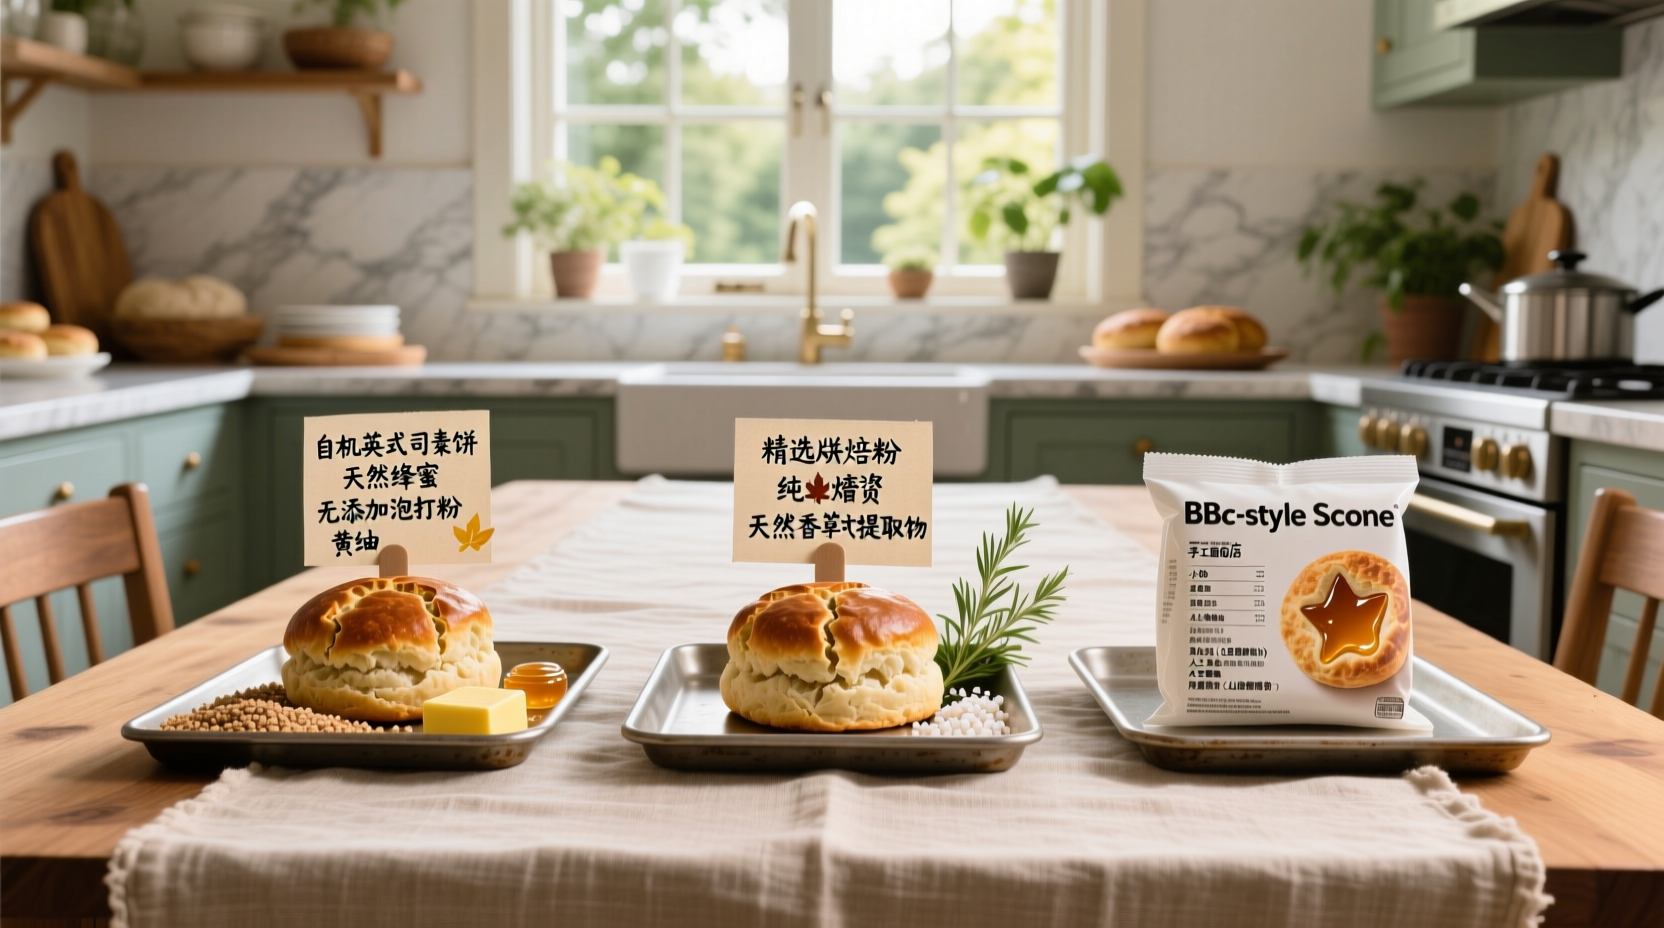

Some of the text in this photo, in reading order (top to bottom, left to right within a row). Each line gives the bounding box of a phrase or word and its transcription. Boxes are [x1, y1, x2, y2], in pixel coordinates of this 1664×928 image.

[317, 495, 462, 524] 无添加泡打粉
[1185, 501, 1306, 533] BBc-style
